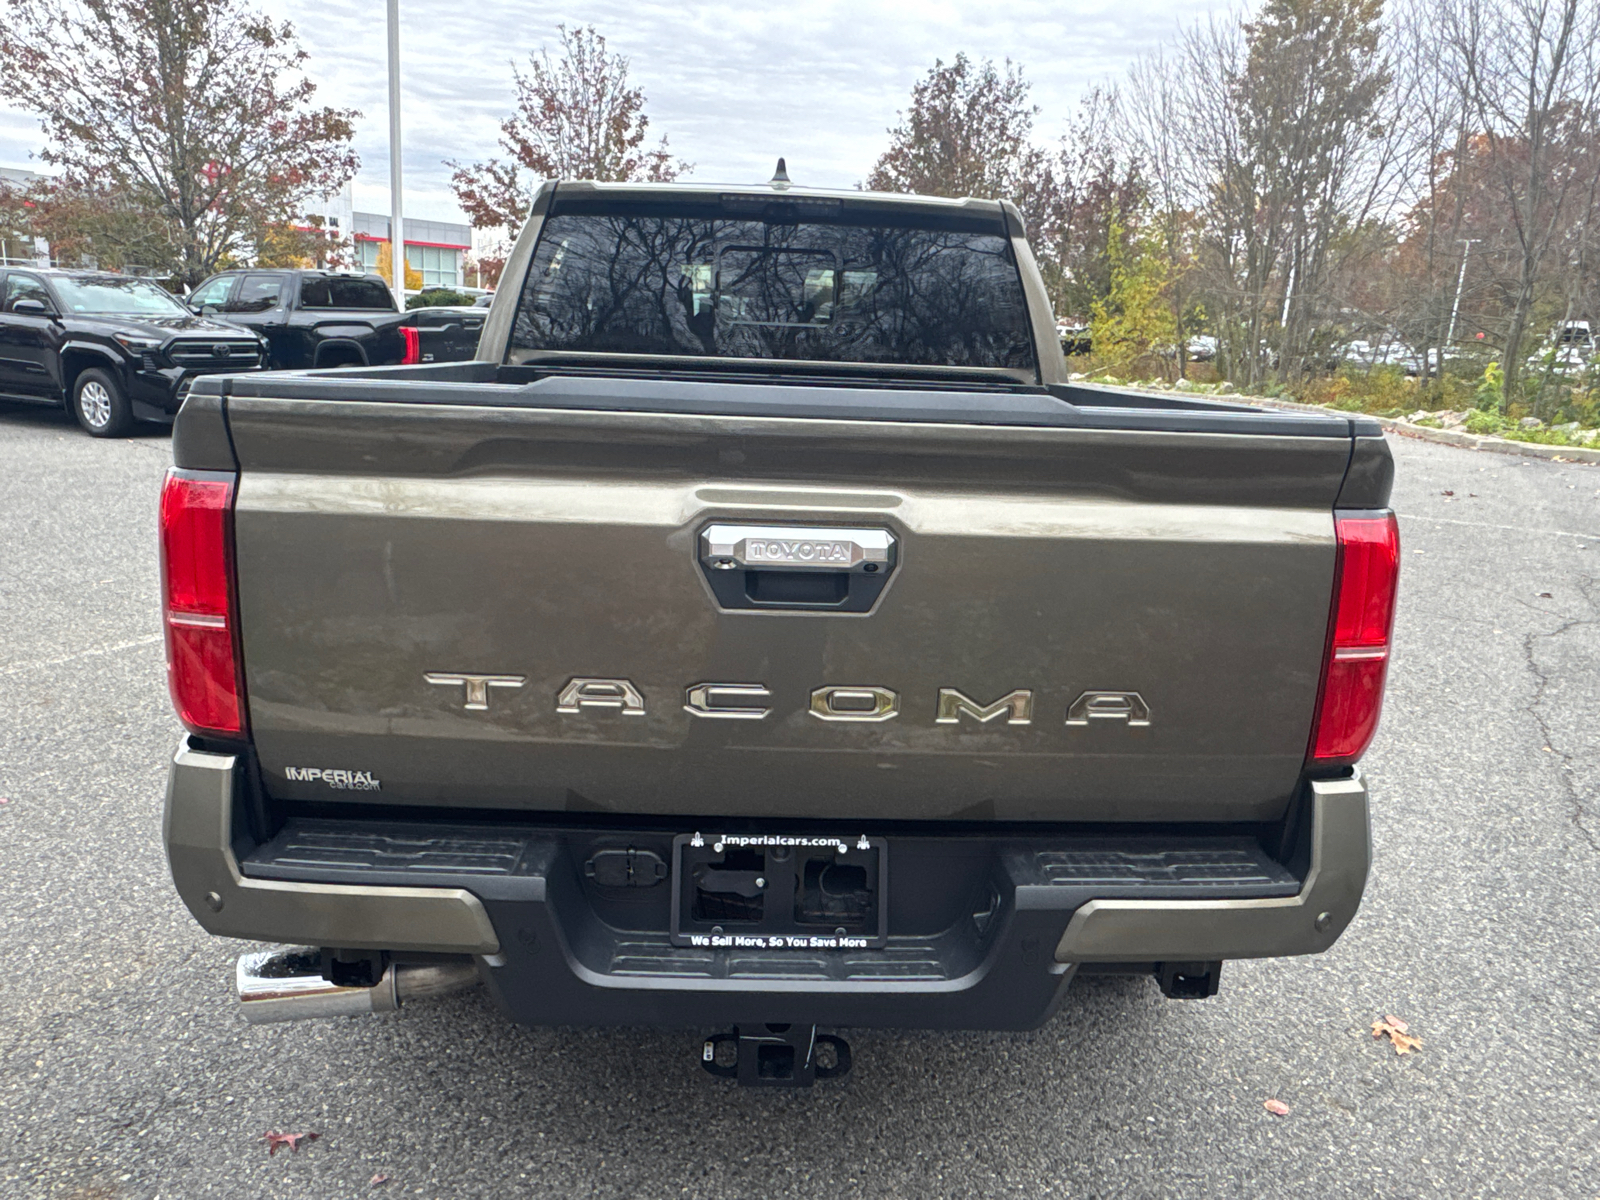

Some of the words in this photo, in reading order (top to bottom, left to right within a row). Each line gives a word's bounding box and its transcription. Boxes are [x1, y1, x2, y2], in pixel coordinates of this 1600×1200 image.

[750, 541, 847, 561] TOYOTA
[423, 673, 1151, 726] TACOMA
[285, 767, 380, 785] IMPERIAL
[329, 781, 381, 791] cars.com
[721, 835, 841, 847] Imperialcars.com
[691, 935, 710, 946] We
[711, 935, 733, 946] Sell
[735, 936, 767, 948] More,
[768, 936, 784, 947] So
[786, 936, 808, 947] You
[809, 936, 837, 947] Save
[839, 937, 867, 948] More
